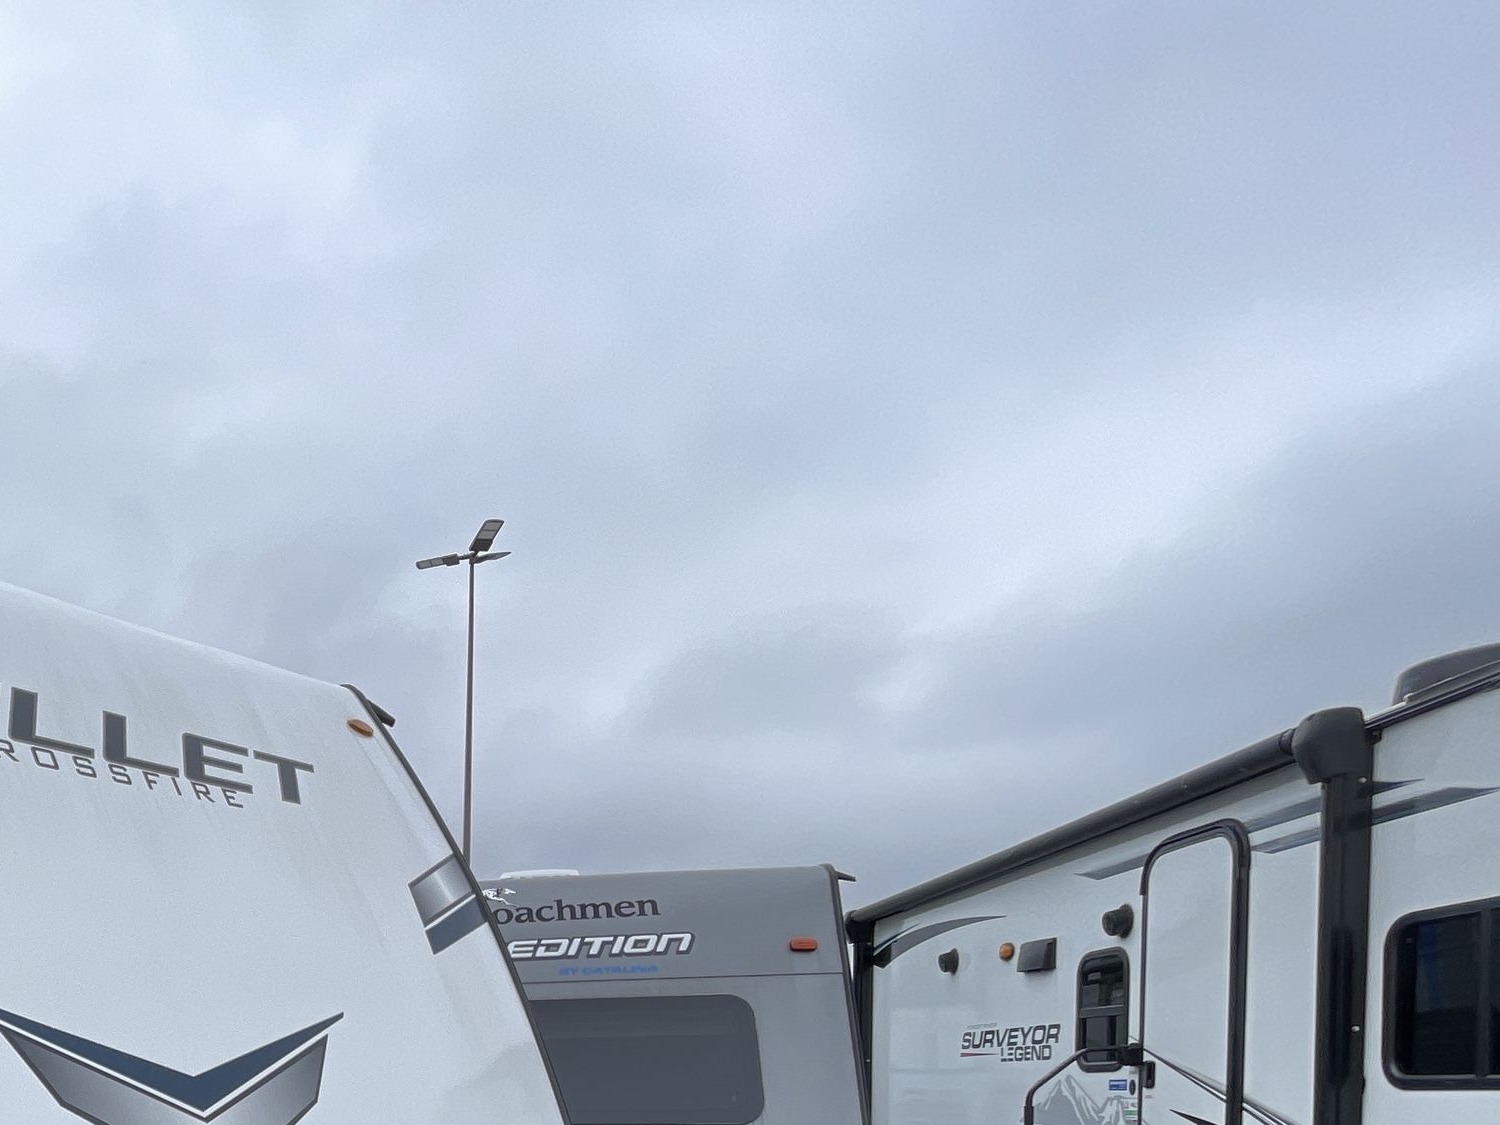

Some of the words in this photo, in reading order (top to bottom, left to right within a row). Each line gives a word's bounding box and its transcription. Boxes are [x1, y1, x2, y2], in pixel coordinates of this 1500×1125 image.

[494, 898, 661, 925] oachmen
[507, 932, 696, 961] EDITION
[961, 1023, 1061, 1050] SURVEYOR
[1000, 1044, 1053, 1063] LEGEND
